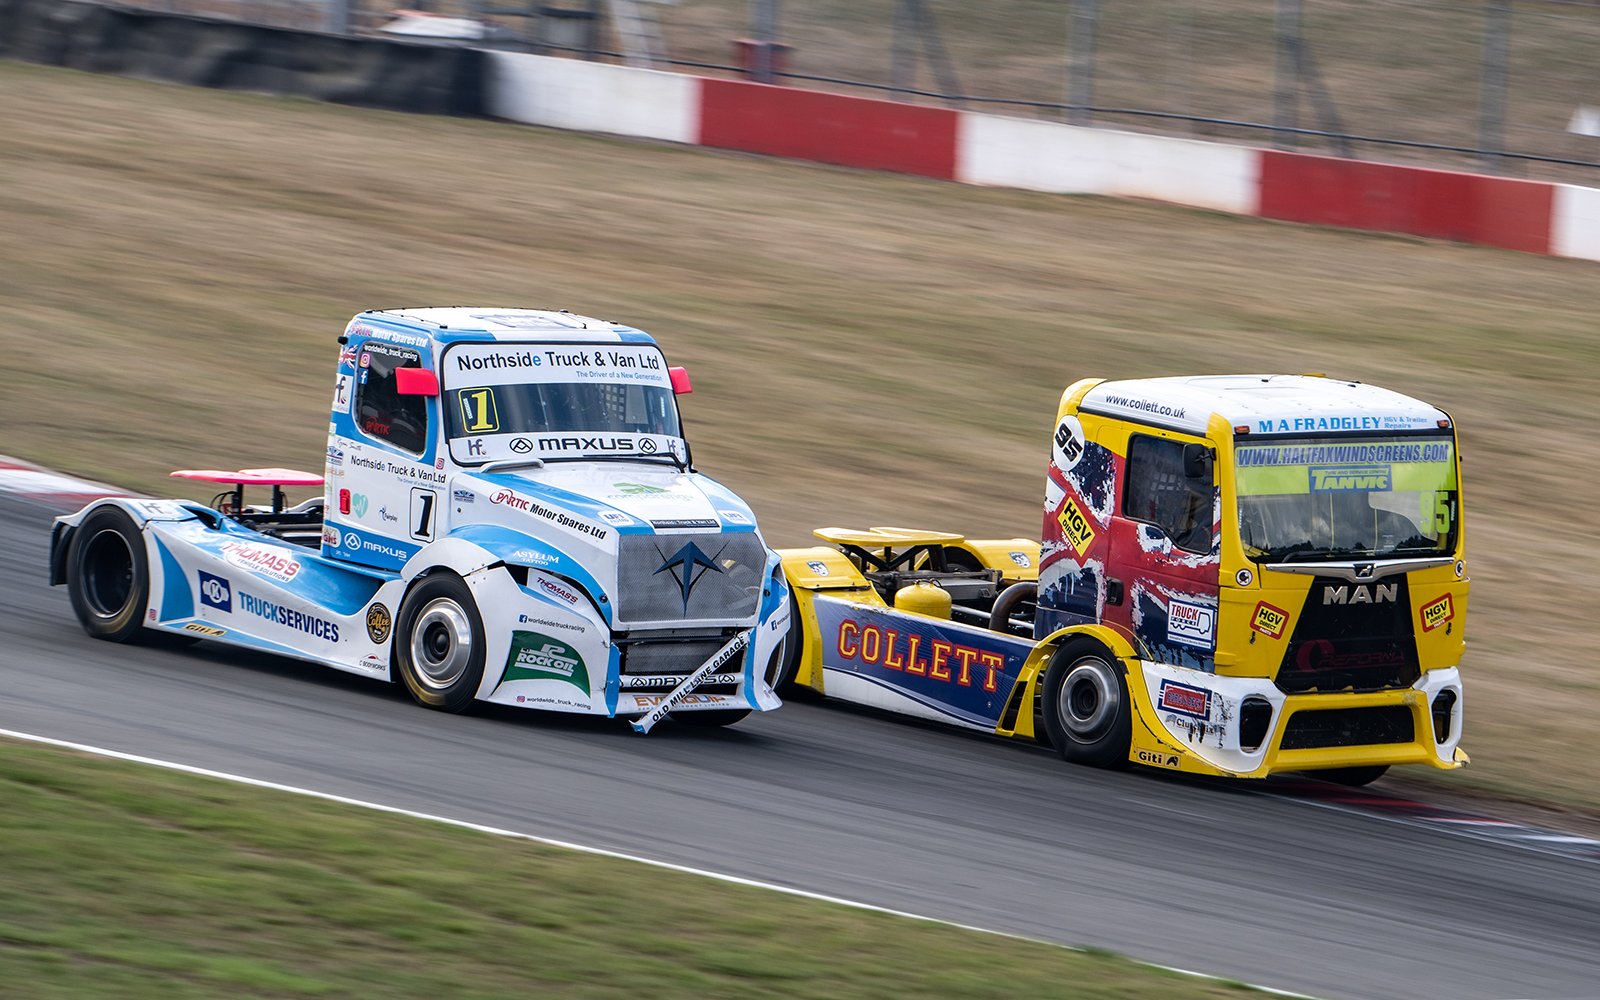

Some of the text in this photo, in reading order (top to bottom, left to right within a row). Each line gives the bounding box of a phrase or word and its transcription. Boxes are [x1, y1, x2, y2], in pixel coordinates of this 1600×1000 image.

[372, 328, 391, 341] Motor
[391, 332, 416, 345] Spares
[416, 337, 428, 348] Ltd
[456, 350, 660, 371] Northside Truck & Van Ltd
[576, 370, 588, 378] The
[589, 370, 607, 378] Driver
[634, 372, 662, 381] Generation
[471, 390, 493, 430] 1
[1105, 394, 1186, 419] www.collett.co.uk
[1258, 420, 1273, 433] M
[1278, 419, 1290, 431] A
[1294, 416, 1382, 430] FRADGLEY
[538, 437, 634, 451] MAXUS
[1054, 422, 1083, 462] 95
[1236, 443, 1449, 468] WWW.HALIFAXWINDSCREENS.COM
[351, 455, 385, 471] Northside
[387, 463, 408, 476] Truck
[409, 467, 416, 478] &
[418, 469, 432, 482] Van
[433, 472, 446, 484] Ltd
[1311, 469, 1388, 490] TANVIC
[414, 495, 434, 538] 1
[492, 489, 530, 511] PARTIC
[530, 503, 557, 521] Motor
[557, 513, 590, 534] Spares
[590, 526, 607, 540] Ltd
[1064, 501, 1092, 541] HGV
[1419, 491, 1450, 534] 95
[1062, 518, 1081, 547] DIRECT
[363, 541, 407, 558] MAXUS
[513, 550, 559, 563] ASYLUM
[237, 558, 290, 582] VEHICLE SOLUTIONS
[522, 557, 549, 566] TATTOO
[1322, 583, 1398, 605] MAN
[1171, 604, 1199, 620] TRUCK
[1259, 608, 1283, 625] HGV
[1425, 600, 1447, 620] HGV
[1259, 619, 1277, 631] DIRECT
[517, 652, 574, 673] ROCK OIL
[837, 618, 1004, 693] COLLETT
[648, 675, 718, 687] MAXS
[652, 704, 670, 722] OLD
[670, 687, 691, 707] MILL
[713, 636, 746, 668] GARAGE
[527, 697, 591, 710] worldwide_truck_racing
[1138, 750, 1163, 764] Giti
